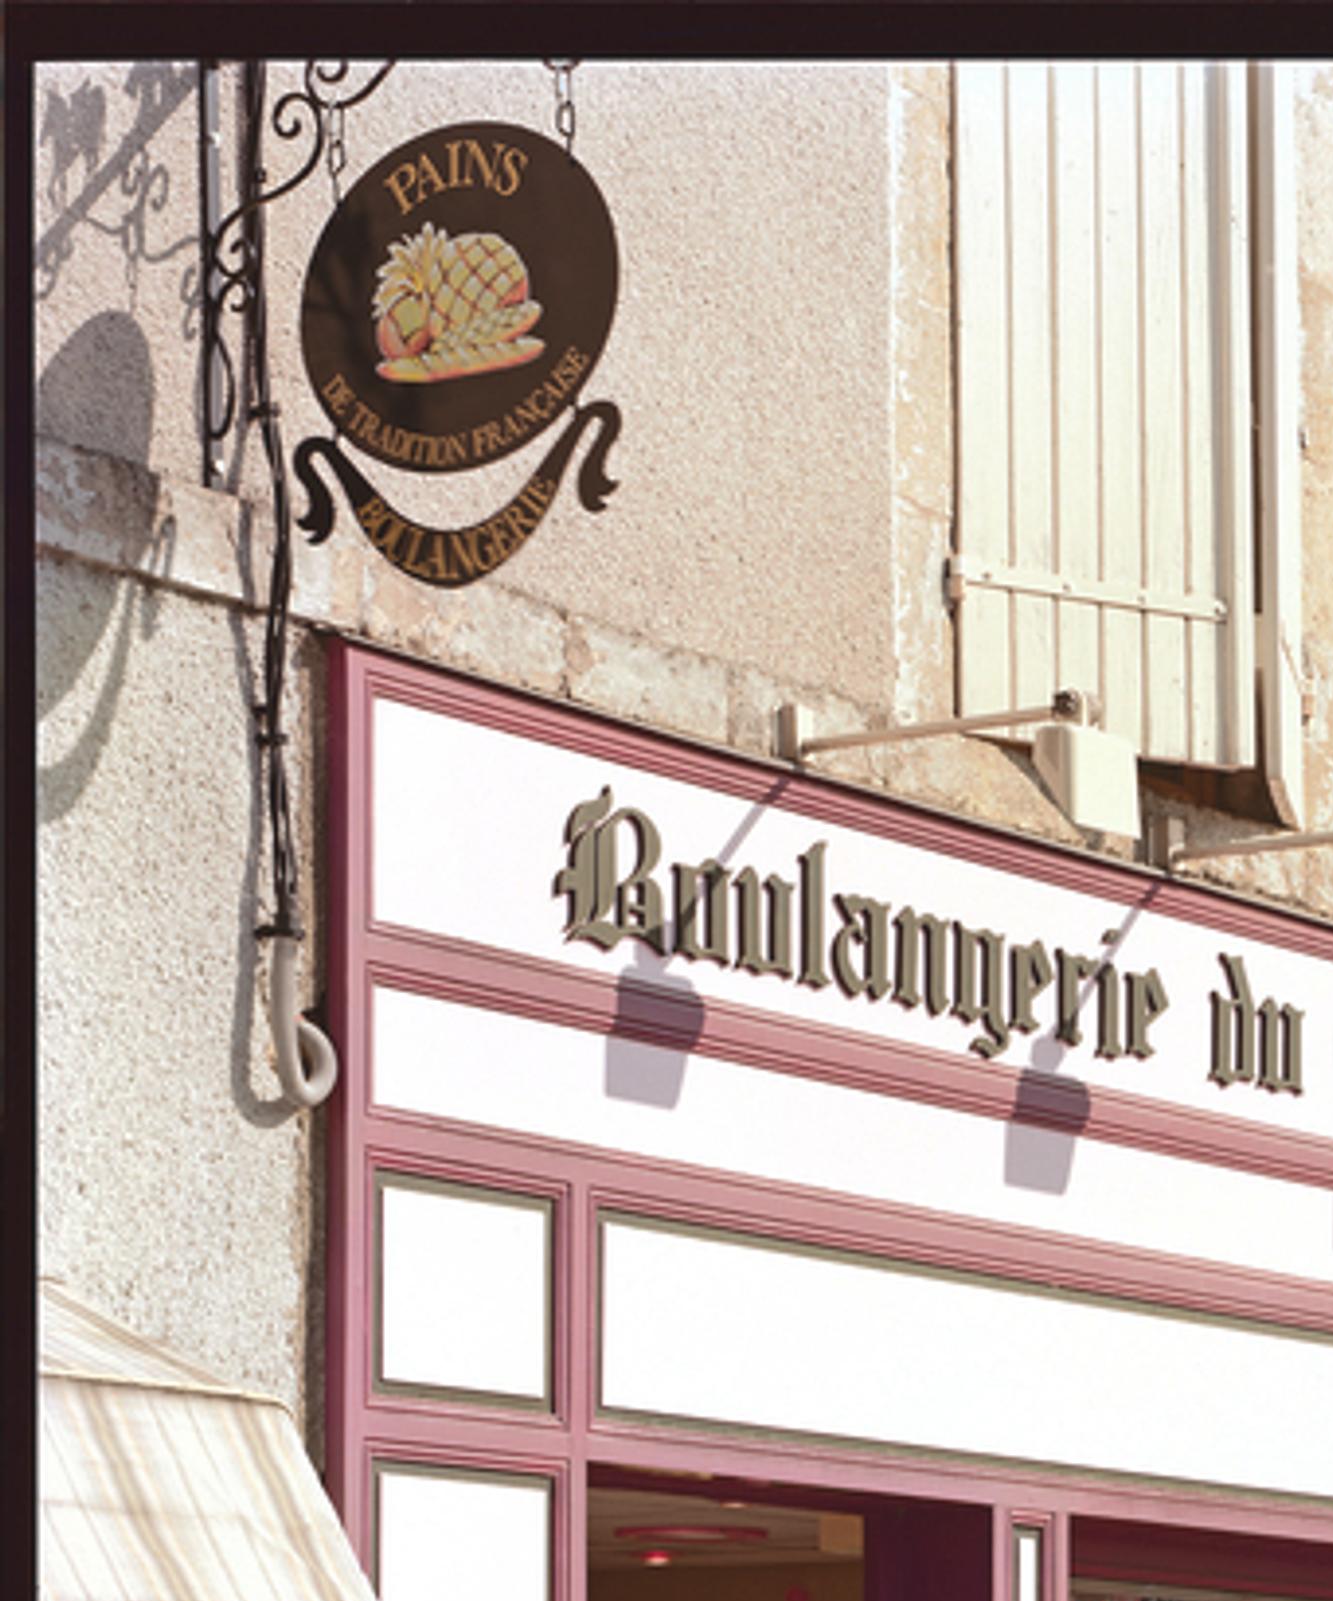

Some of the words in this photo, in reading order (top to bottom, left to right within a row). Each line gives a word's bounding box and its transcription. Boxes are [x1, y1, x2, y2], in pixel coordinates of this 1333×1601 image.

[384, 139, 529, 215] PAINS
[321, 373, 356, 414] DE
[349, 402, 467, 465] TRADITION
[472, 346, 591, 457] FRANÇAISE
[356, 475, 557, 580] BOULANGERIE
[551, 784, 1170, 1061] Boulangerie
[1206, 952, 1305, 1098] du
